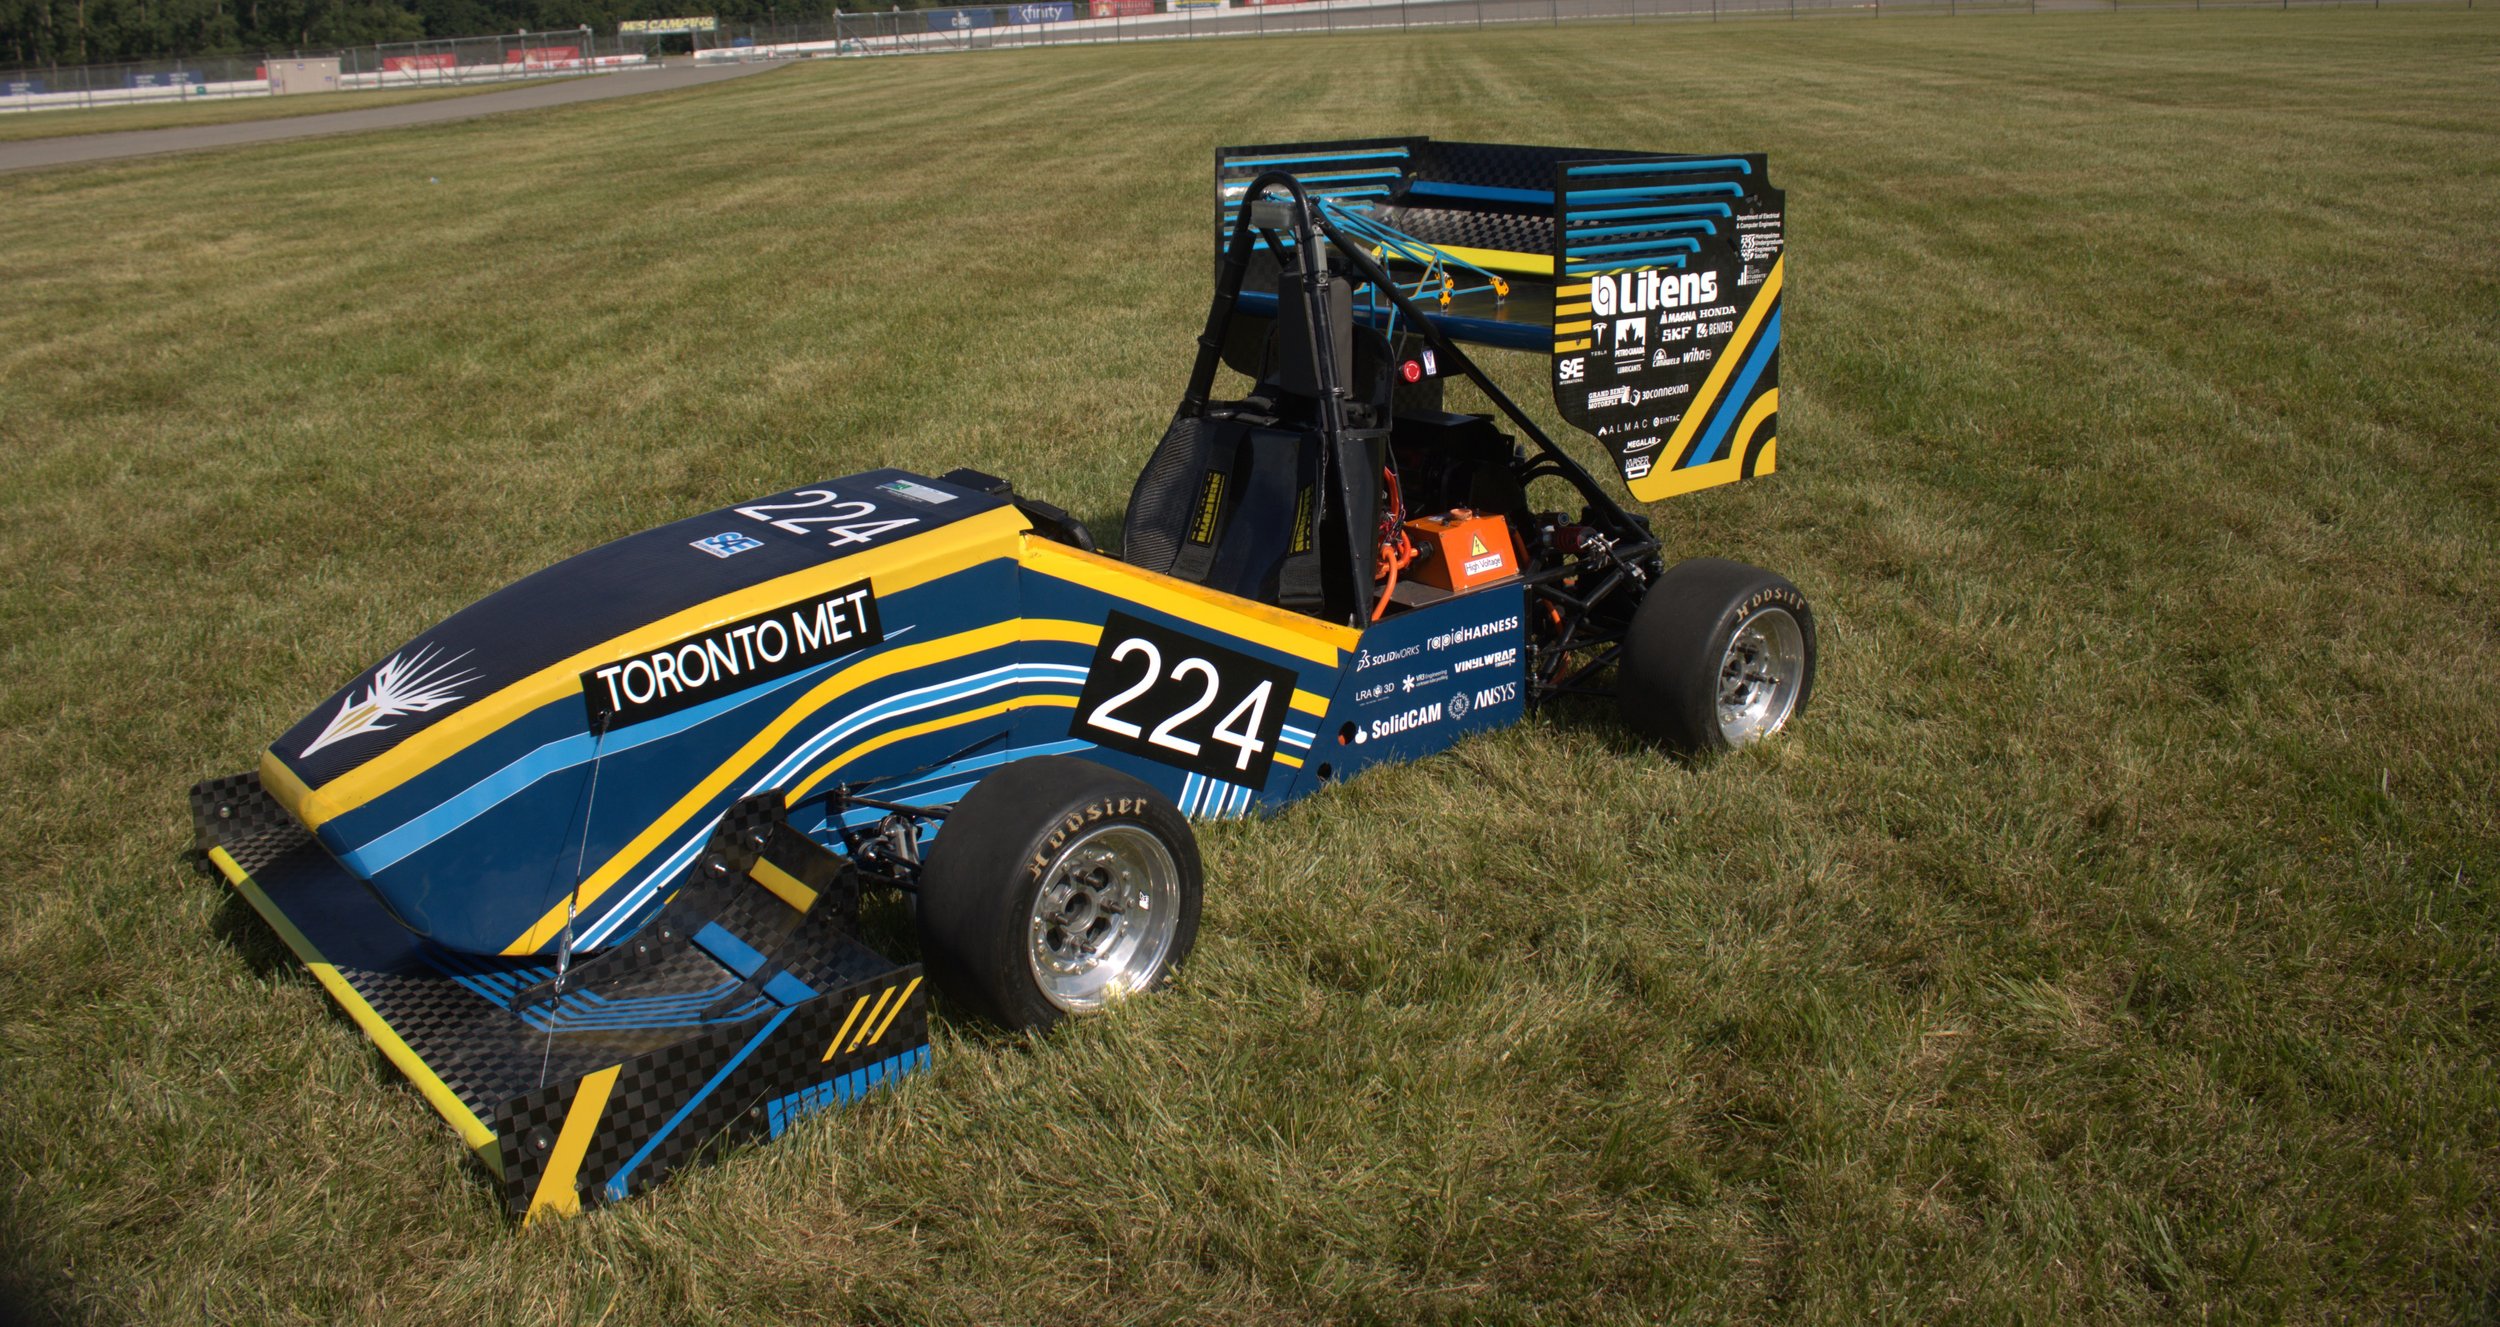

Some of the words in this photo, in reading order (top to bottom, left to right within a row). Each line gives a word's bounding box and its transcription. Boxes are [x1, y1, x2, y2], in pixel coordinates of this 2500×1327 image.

[649, 16, 716, 31] CAMPING
[1620, 270, 1718, 314] Litens
[1668, 311, 1697, 323] MAGNA
[1699, 305, 1737, 318] HONDA
[1662, 327, 1692, 342] SKF
[1708, 321, 1733, 335] BENDER
[1683, 347, 1705, 363] wiha
[1559, 357, 1585, 379] SAE
[1617, 364, 1642, 374] LUBRICANTS
[1588, 390, 1609, 399] GRAND
[1609, 418, 1648, 434] ALMAC
[1627, 436, 1657, 449] MEGALAB
[1625, 455, 1650, 468] KVASER
[734, 489, 920, 547] 224
[1466, 562, 1480, 573] High
[1480, 557, 1501, 570] Voltage
[596, 619, 788, 713] TORONTO
[792, 589, 868, 655] MET
[1372, 644, 1420, 666] SOLIDWORKS
[1356, 689, 1372, 702] LRA
[1384, 682, 1395, 693] 3D
[1474, 682, 1517, 710] ANSYS
[1087, 637, 1273, 771] 224
[1372, 702, 1442, 740] SolidCAM
